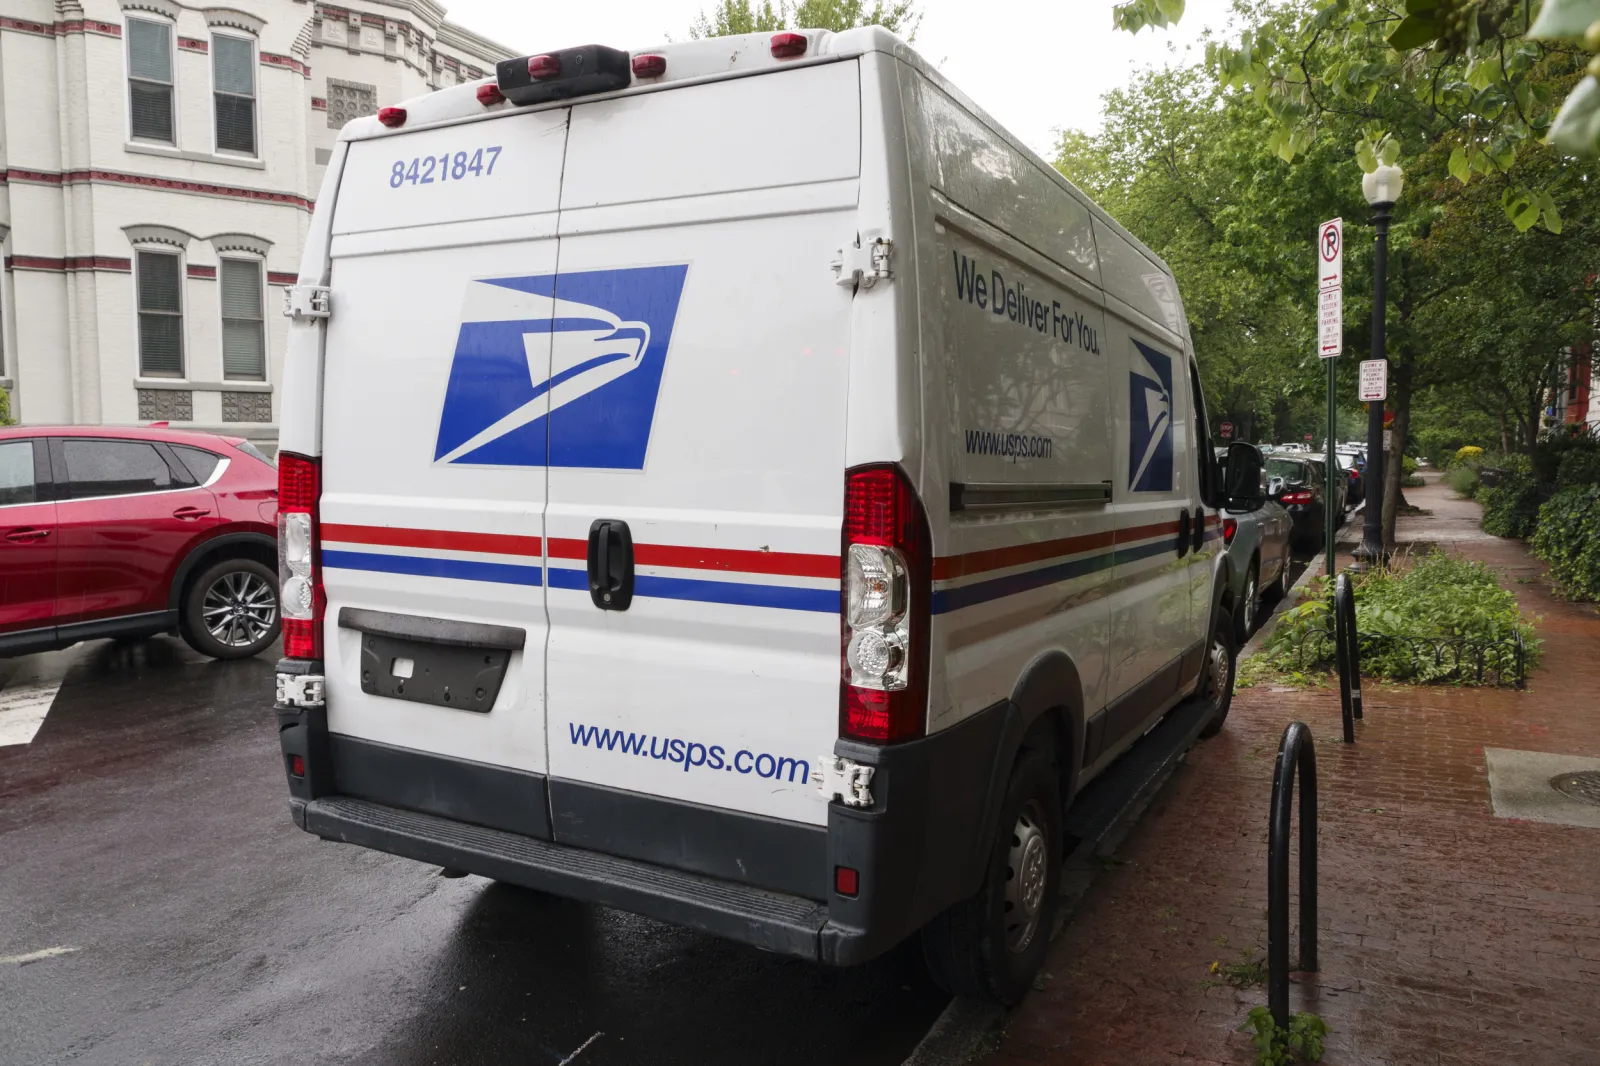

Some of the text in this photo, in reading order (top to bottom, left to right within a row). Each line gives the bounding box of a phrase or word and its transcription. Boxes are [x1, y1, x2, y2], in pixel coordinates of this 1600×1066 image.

[390, 146, 502, 188] 8421847
[953, 250, 1100, 355] We Deliver For You.
[1321, 301, 1339, 310] RESIDENT
[1321, 317, 1339, 326] PARKING
[965, 429, 1052, 465] www.usps.com
[569, 722, 810, 785] www.usps.com
